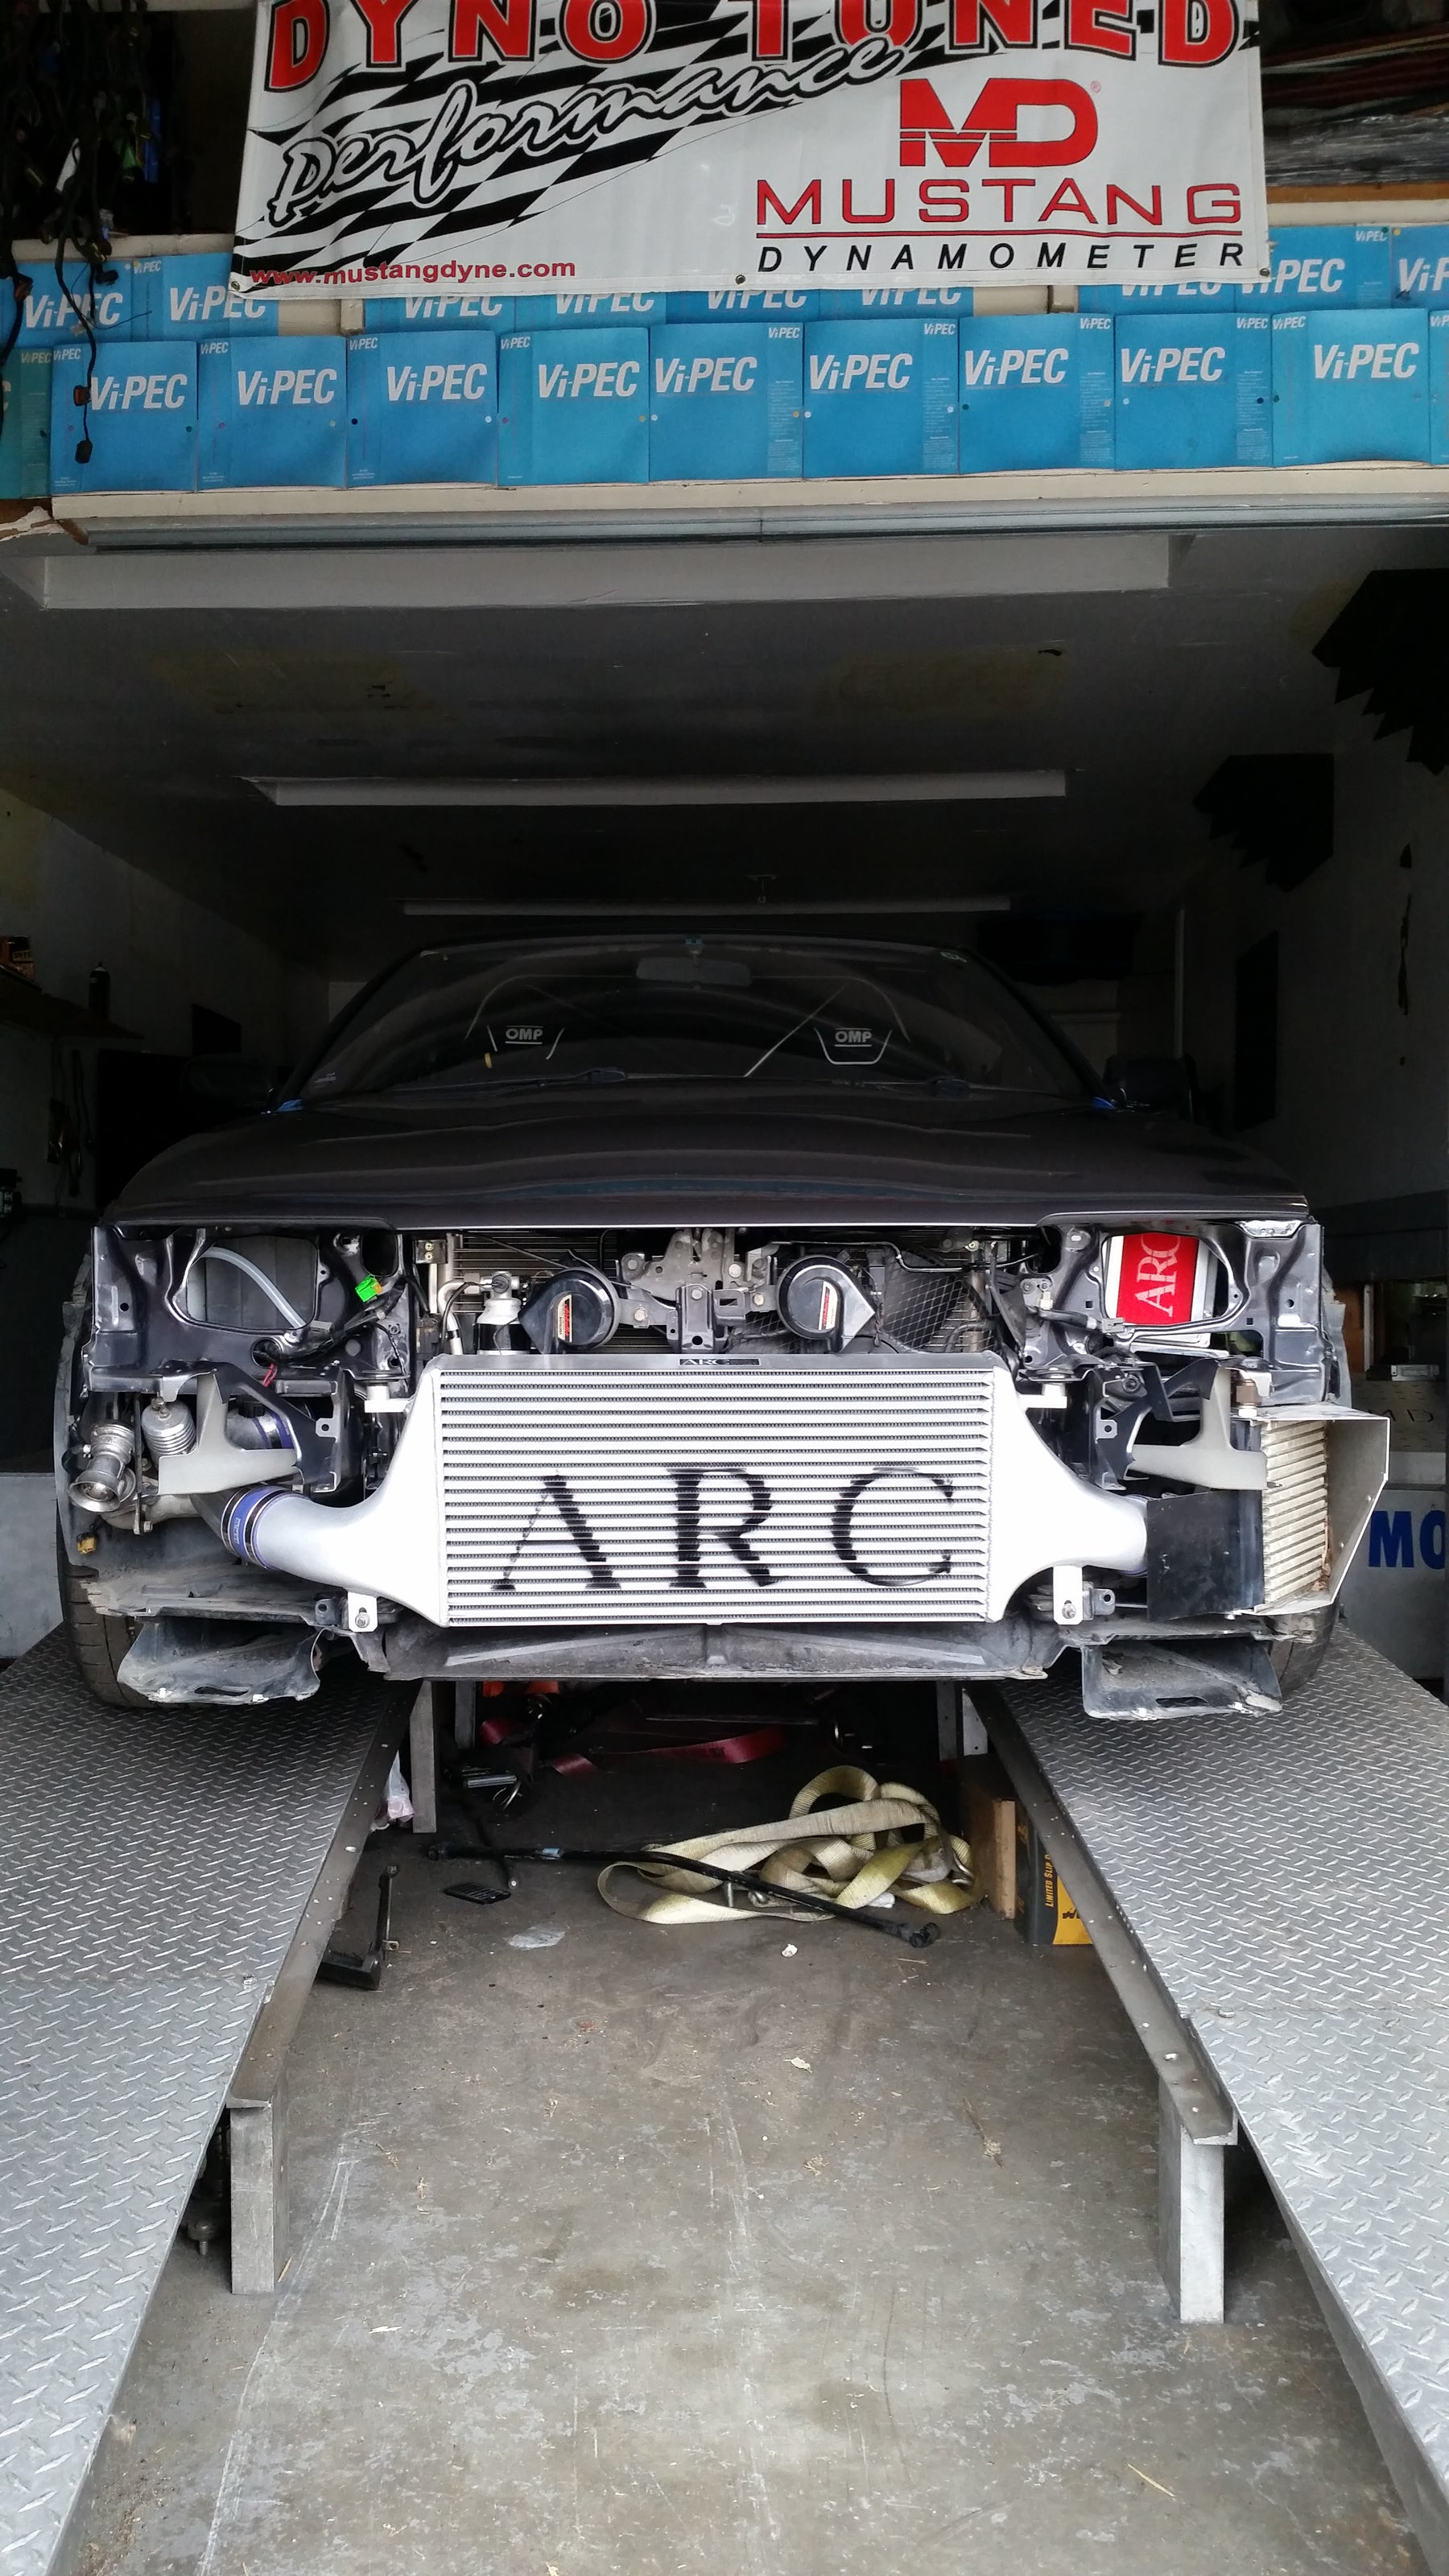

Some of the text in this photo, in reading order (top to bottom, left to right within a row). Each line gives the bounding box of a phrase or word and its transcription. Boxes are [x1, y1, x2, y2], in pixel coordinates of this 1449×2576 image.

[264, 0, 653, 93] DYNO
[266, 36, 907, 228] Performance
[900, 77, 1098, 167] MD
[757, 177, 1241, 226] MUSTANG
[250, 259, 576, 285] www.mustangdyne.com
[758, 242, 1244, 272] DYNAMOMETER
[506, 1028, 543, 1040] OMP
[835, 1030, 872, 1042] OMP
[491, 1467, 954, 1591] ARC
